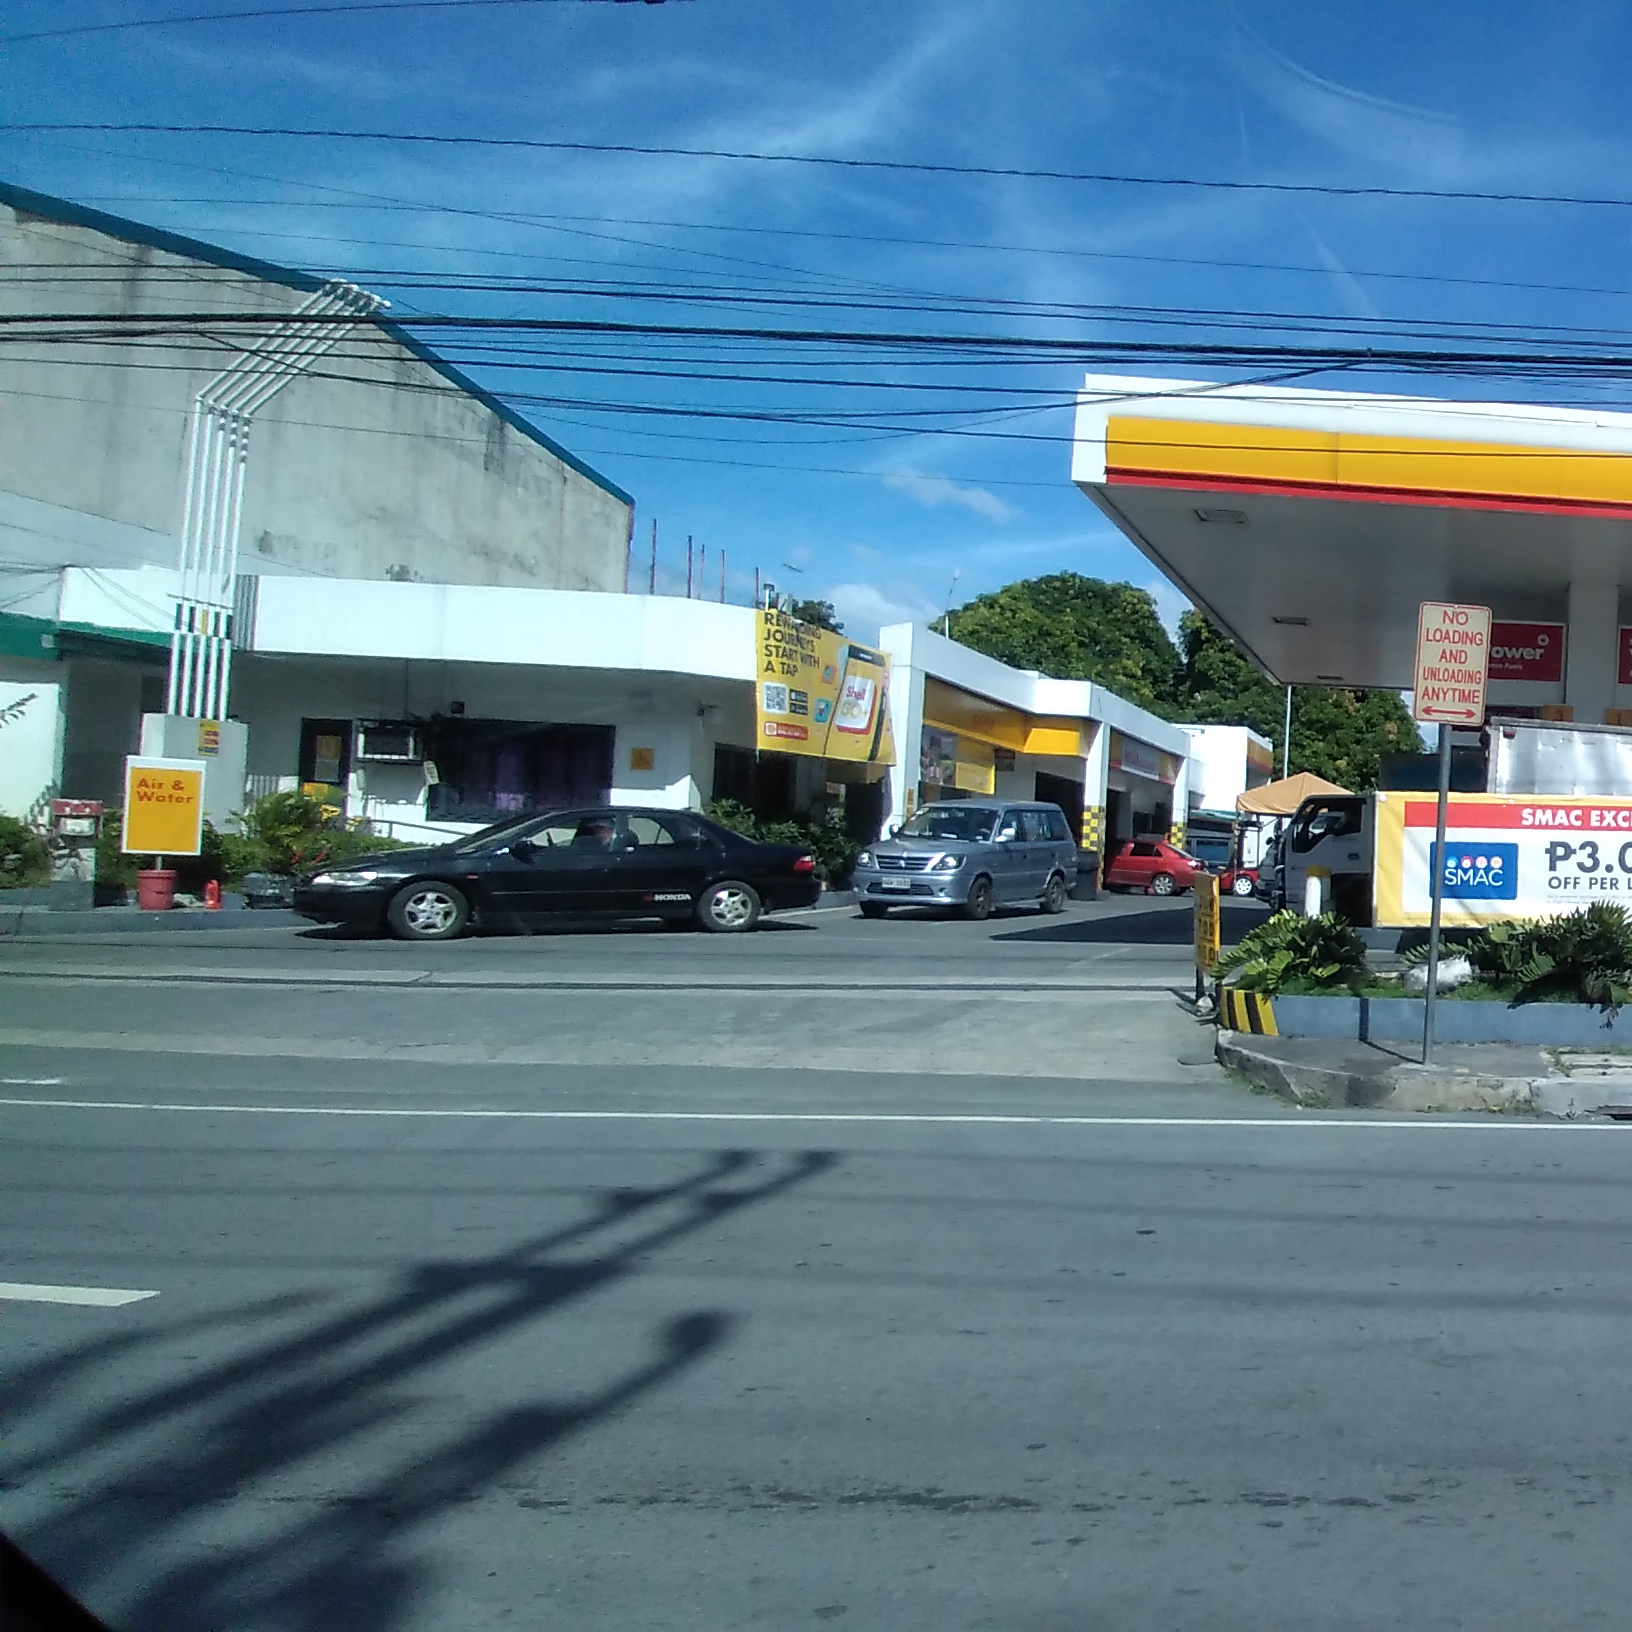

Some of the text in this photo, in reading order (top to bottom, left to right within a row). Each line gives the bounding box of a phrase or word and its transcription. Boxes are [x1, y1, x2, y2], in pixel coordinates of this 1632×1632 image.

[1442, 610, 1469, 626] NO
[1425, 628, 1484, 646] LOADING
[764, 644, 820, 669] START WITH
[1438, 648, 1468, 664] AND
[1490, 646, 1545, 660] ower
[763, 660, 798, 677] A TAP
[1422, 666, 1482, 685] UNLOADING
[846, 685, 868, 701] Shell
[1421, 686, 1481, 704] ANYTIME
[136, 778, 185, 791] Air &
[136, 791, 194, 804] Water
[1521, 808, 1583, 827] SMAC
[1444, 868, 1503, 886] SMAC
[1547, 876, 1581, 890] OFF
[1588, 877, 1620, 890] PER
[654, 893, 692, 901] HONDA
